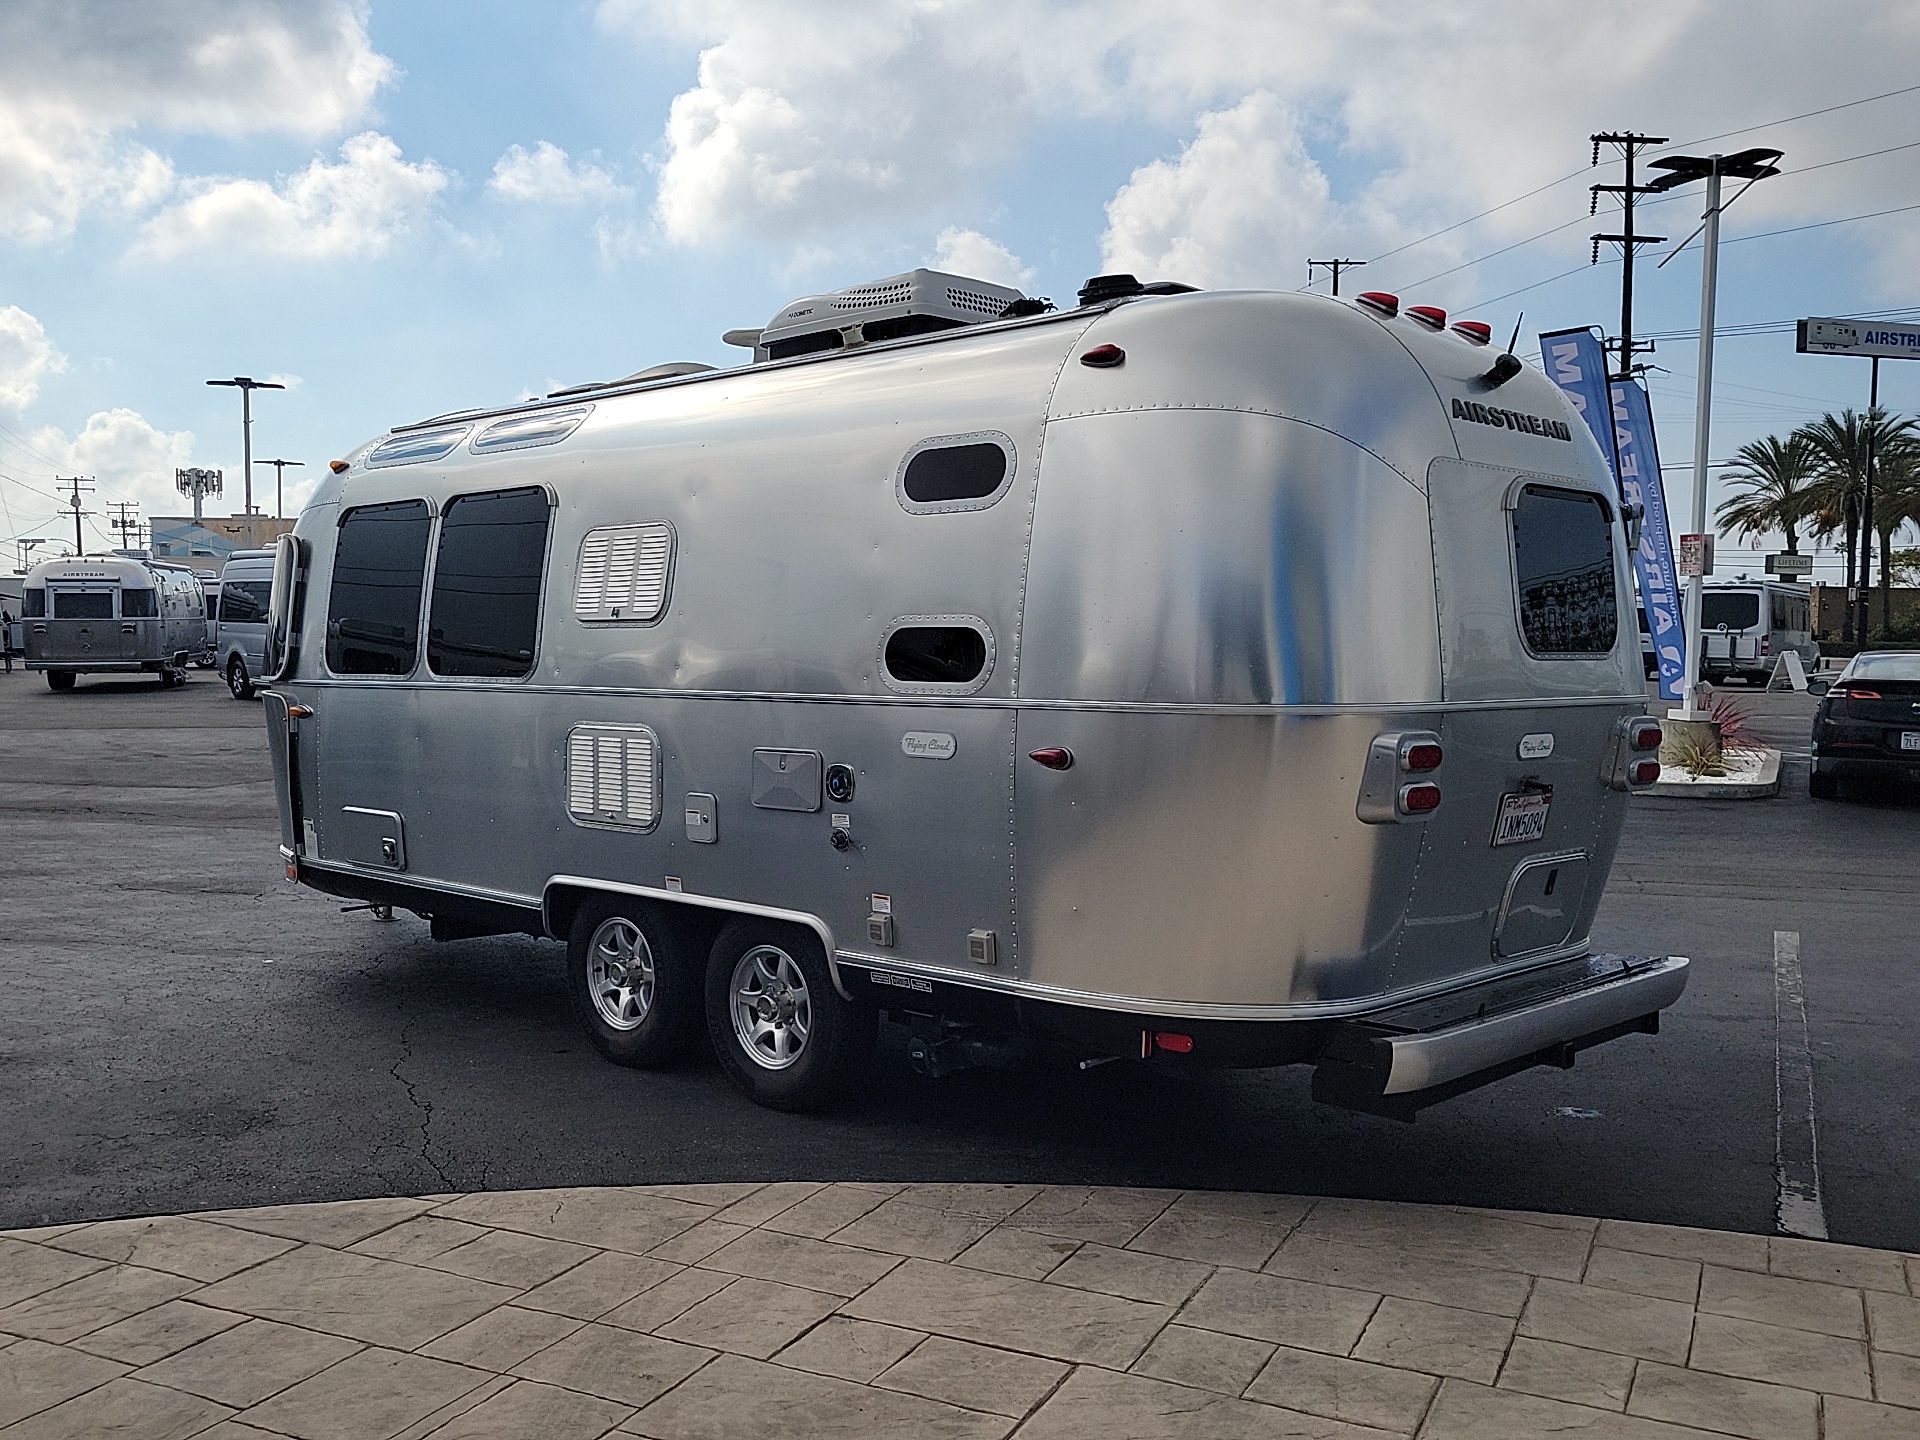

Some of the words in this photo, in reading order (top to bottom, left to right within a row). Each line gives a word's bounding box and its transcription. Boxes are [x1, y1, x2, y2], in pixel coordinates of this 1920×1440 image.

[1864, 330, 1920, 347] AIRSTR
[1451, 398, 1572, 442] AIRSTREAM
[905, 737, 928, 753] Flying
[928, 738, 951, 751] Cloud
[1500, 811, 1545, 839] 1NM5094
